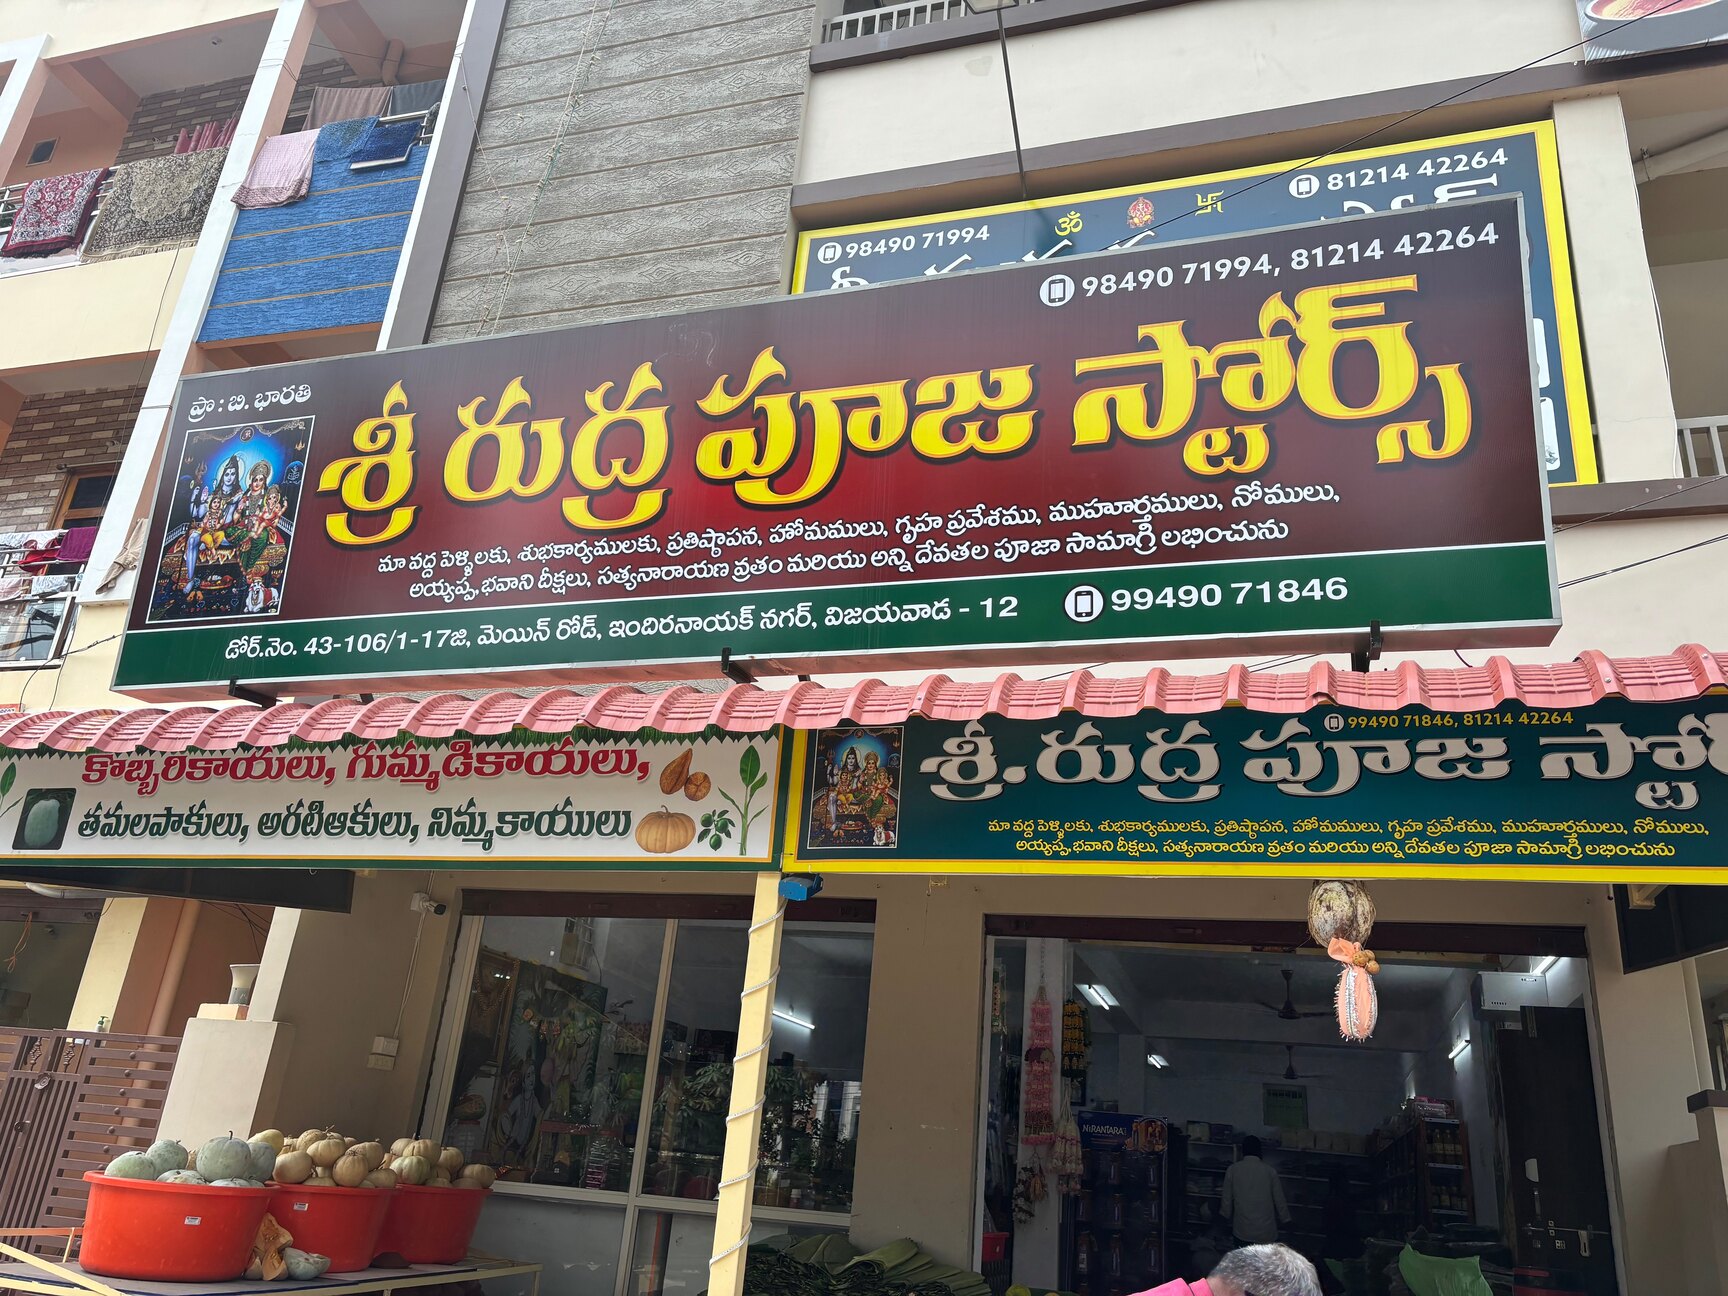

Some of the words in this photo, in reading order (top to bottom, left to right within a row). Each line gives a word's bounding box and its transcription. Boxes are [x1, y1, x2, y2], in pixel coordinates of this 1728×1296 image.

[1327, 164, 1409, 191] 81214
[1417, 148, 1508, 175] 42264
[846, 236, 915, 258] 98490
[922, 225, 990, 249] 71994
[1082, 267, 1174, 297] 98490
[1182, 254, 1280, 284] 71994,
[1291, 238, 1384, 270] 81214
[1394, 222, 1499, 256] 42264
[254, 384, 311, 411] భారతి
[317, 379, 419, 545] శ్రీ
[444, 362, 669, 530] రుద్ర
[696, 346, 1038, 504] పూజ
[1072, 274, 1471, 475] స్టోర్స్
[378, 555, 406, 573] మా
[409, 553, 436, 578] వద్ద
[517, 535, 661, 565] శుభకార్యములకు,
[769, 518, 888, 545] హోమములు,
[895, 512, 942, 544] గృహ
[946, 503, 1042, 537] ప్రవేశము,
[1049, 492, 1224, 523] ముహూర్తములు,
[1232, 480, 1340, 508] నోములు,
[537, 567, 591, 595] దీక్షలు,
[597, 556, 729, 591] సత్యనారాయణ
[731, 556, 783, 583] వ్రతం
[787, 550, 866, 572] మరియు
[870, 544, 914, 573] అన్ని
[915, 539, 989, 565] దేవతల
[993, 537, 1061, 563] పూజా
[1066, 522, 1157, 555] సామాగ్రి
[1161, 518, 1289, 549] లభించును
[1111, 583, 1222, 612] 99490
[1230, 577, 1348, 605] 71846
[477, 617, 551, 646] మెయిన్
[556, 614, 602, 642] రోడ్,
[608, 604, 756, 639] ఇందిరనాయక్
[759, 602, 817, 631] నగర్,
[824, 597, 952, 627] విజయవాడ
[979, 595, 1018, 619] 12
[1348, 715, 1398, 729] 99490
[1403, 714, 1458, 728] 71846,
[1463, 713, 1513, 726] 81214
[1518, 712, 1574, 725] 42264
[81, 745, 338, 797] కొబ్బరికాయలు,
[345, 736, 651, 792] గుమ్మడికాయలు,
[1036, 720, 1224, 803] రుద్ర
[1240, 717, 1512, 797] పూజ
[77, 799, 250, 844] తమలపాకులు,
[257, 798, 420, 844] అరటిఆకులు,
[988, 820, 1010, 832] మా
[1013, 820, 1035, 838] వద్ద
[1098, 819, 1210, 837] శుభకార్యములకు,
[1388, 819, 1424, 840] గృహ
[1426, 816, 1497, 837] ప్రవేశము,
[1633, 816, 1709, 836] నోములు,
[1117, 839, 1158, 857] దీక్షలు,
[1163, 839, 1264, 857] సత్యనారాయణ
[1267, 840, 1305, 857] వ్రతం
[1309, 840, 1368, 854] మరియు
[1371, 840, 1405, 859] అన్ని
[1405, 837, 1460, 854] దేవతల
[1464, 840, 1512, 857] పూజా
[1516, 837, 1583, 860] సామాగ్రి
[1585, 842, 1676, 859] లభించును
